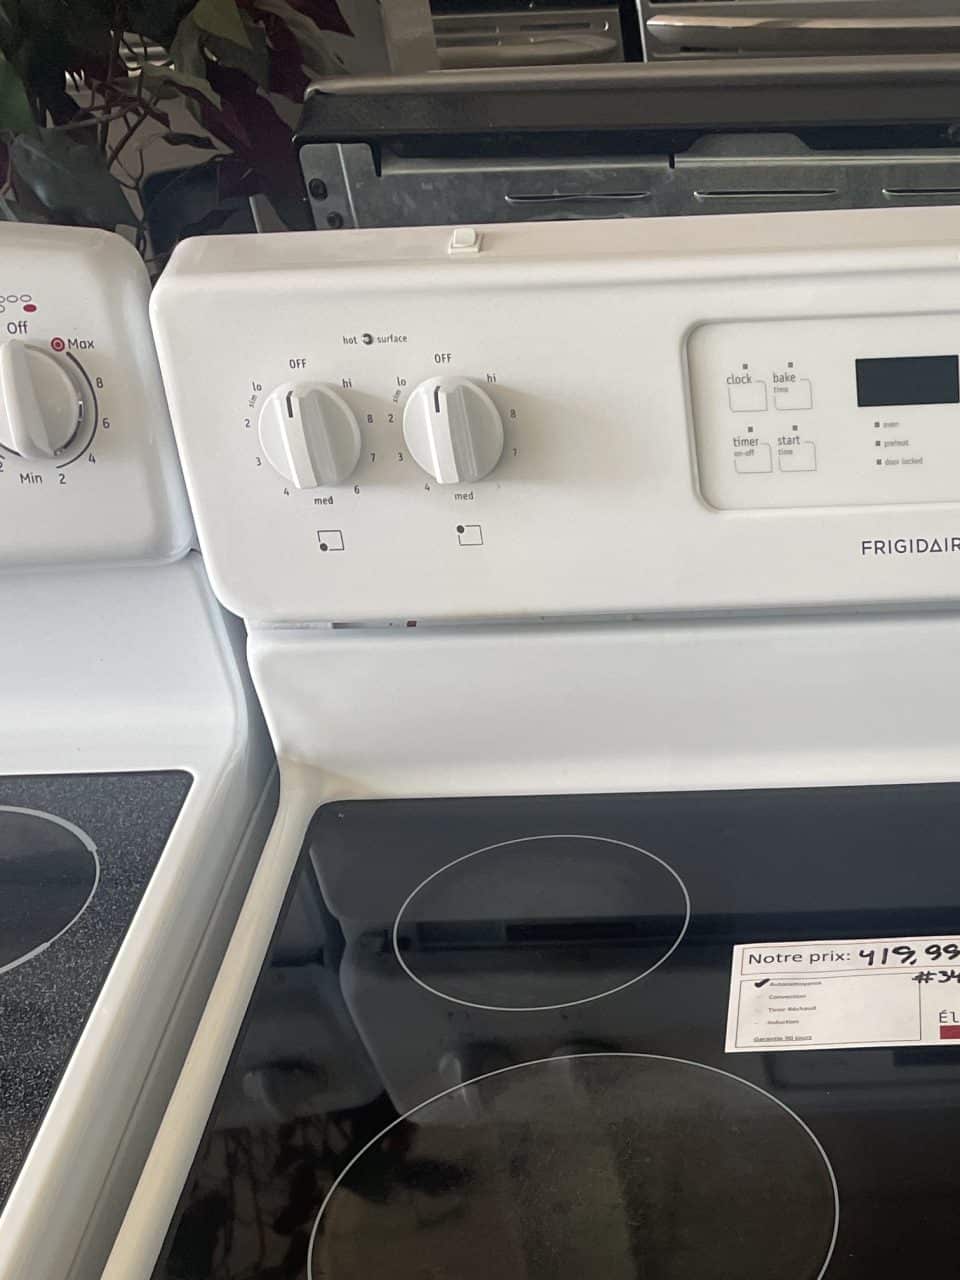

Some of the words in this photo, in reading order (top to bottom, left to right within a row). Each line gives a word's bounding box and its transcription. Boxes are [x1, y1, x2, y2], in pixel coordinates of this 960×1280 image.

[7, 321, 28, 334] Off
[68, 338, 95, 350] Max
[343, 336, 358, 345] hot
[377, 334, 408, 344] surface
[434, 353, 452, 363] OFF
[289, 359, 307, 369] OFF
[96, 377, 104, 388] 8
[397, 376, 407, 386] lo
[487, 373, 496, 383] hi
[726, 372, 752, 384] clock
[773, 372, 796, 383] bake
[252, 381, 262, 391] lo
[342, 378, 352, 388] hi
[102, 418, 110, 429] 6
[245, 419, 250, 428] 2
[388, 414, 394, 423] 2
[733, 436, 759, 447] timer
[777, 435, 800, 446] start
[89, 453, 96, 464] 4
[256, 457, 262, 466] 3
[370, 453, 376, 462] 7
[398, 453, 404, 461] 3
[20, 473, 42, 485] Min
[59, 474, 66, 485] 2
[284, 488, 290, 496] 4
[354, 485, 360, 494] 6
[314, 496, 334, 505] med
[454, 491, 474, 500] med
[748, 953, 802, 965] Notre
[809, 951, 851, 965] prix:
